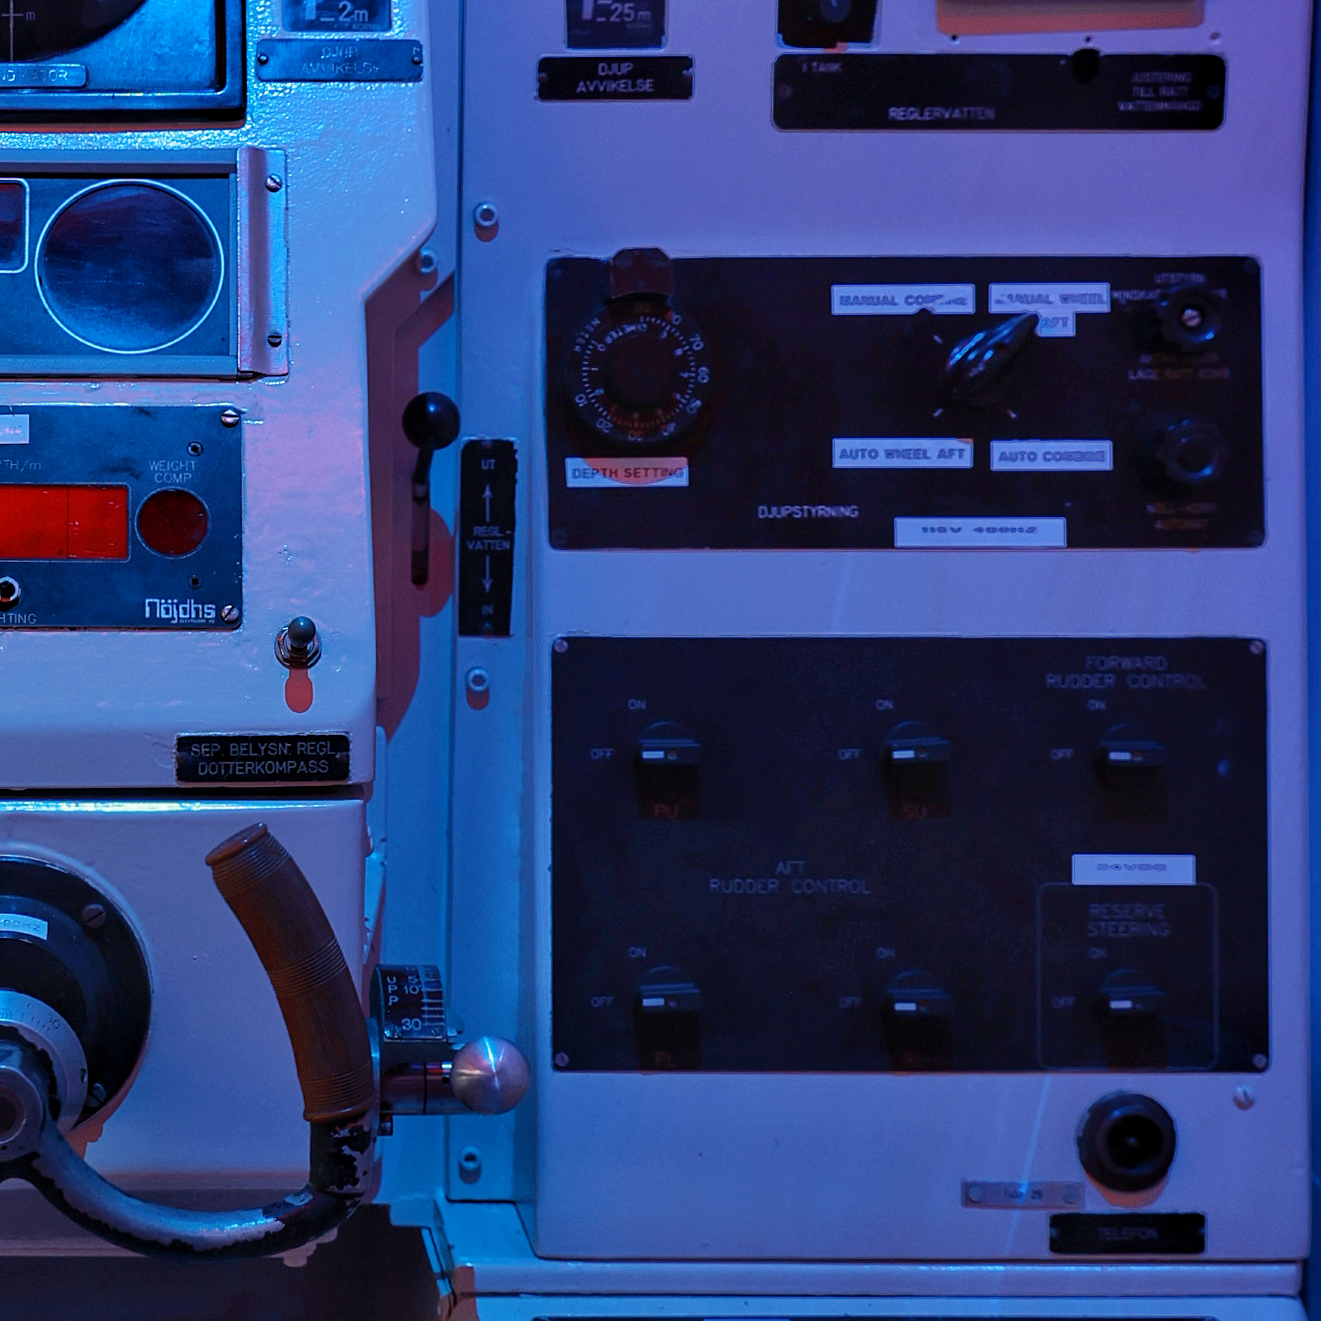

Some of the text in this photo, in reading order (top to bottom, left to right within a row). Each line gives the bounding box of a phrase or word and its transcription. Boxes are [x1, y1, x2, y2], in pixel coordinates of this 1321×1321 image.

[597, 63, 633, 76] DJUP
[576, 80, 654, 94] AVVIKELSE
[888, 107, 996, 121] REGLERVATTEN
[840, 295, 898, 306] MANUAL
[840, 449, 965, 459] AUTO WHEEL AFT
[999, 452, 1037, 462] AUTO
[149, 461, 196, 472] WEIGHT
[481, 459, 496, 470] UT
[154, 472, 193, 483] COMP
[571, 467, 685, 479] DEPTH SETTING
[758, 505, 859, 519] DJUPSTYRNING
[466, 540, 511, 551] VATTEN
[1085, 656, 1168, 671] FORWARD
[1045, 674, 1205, 689] RUDDER CONTROL
[627, 699, 647, 711] ON
[875, 699, 894, 711] ON
[1087, 699, 1107, 711] ON
[191, 743, 225, 757] SEP.
[591, 748, 614, 760] OFF
[838, 748, 862, 760] OFF
[1050, 748, 1075, 760] OFF
[198, 760, 329, 775] DOTTERKOMPASS
[776, 860, 805, 875] AFT
[709, 879, 871, 894] RUDDER CONTROL
[1088, 903, 1166, 919] RESERVE
[1088, 921, 1169, 937] STEERING
[628, 946, 647, 959] ON
[876, 946, 896, 959] ON
[1088, 947, 1108, 959] ON
[591, 996, 614, 1008] OFF
[839, 996, 862, 1008] OFF
[1051, 996, 1075, 1009] OFF
[402, 1018, 422, 1030] 30
